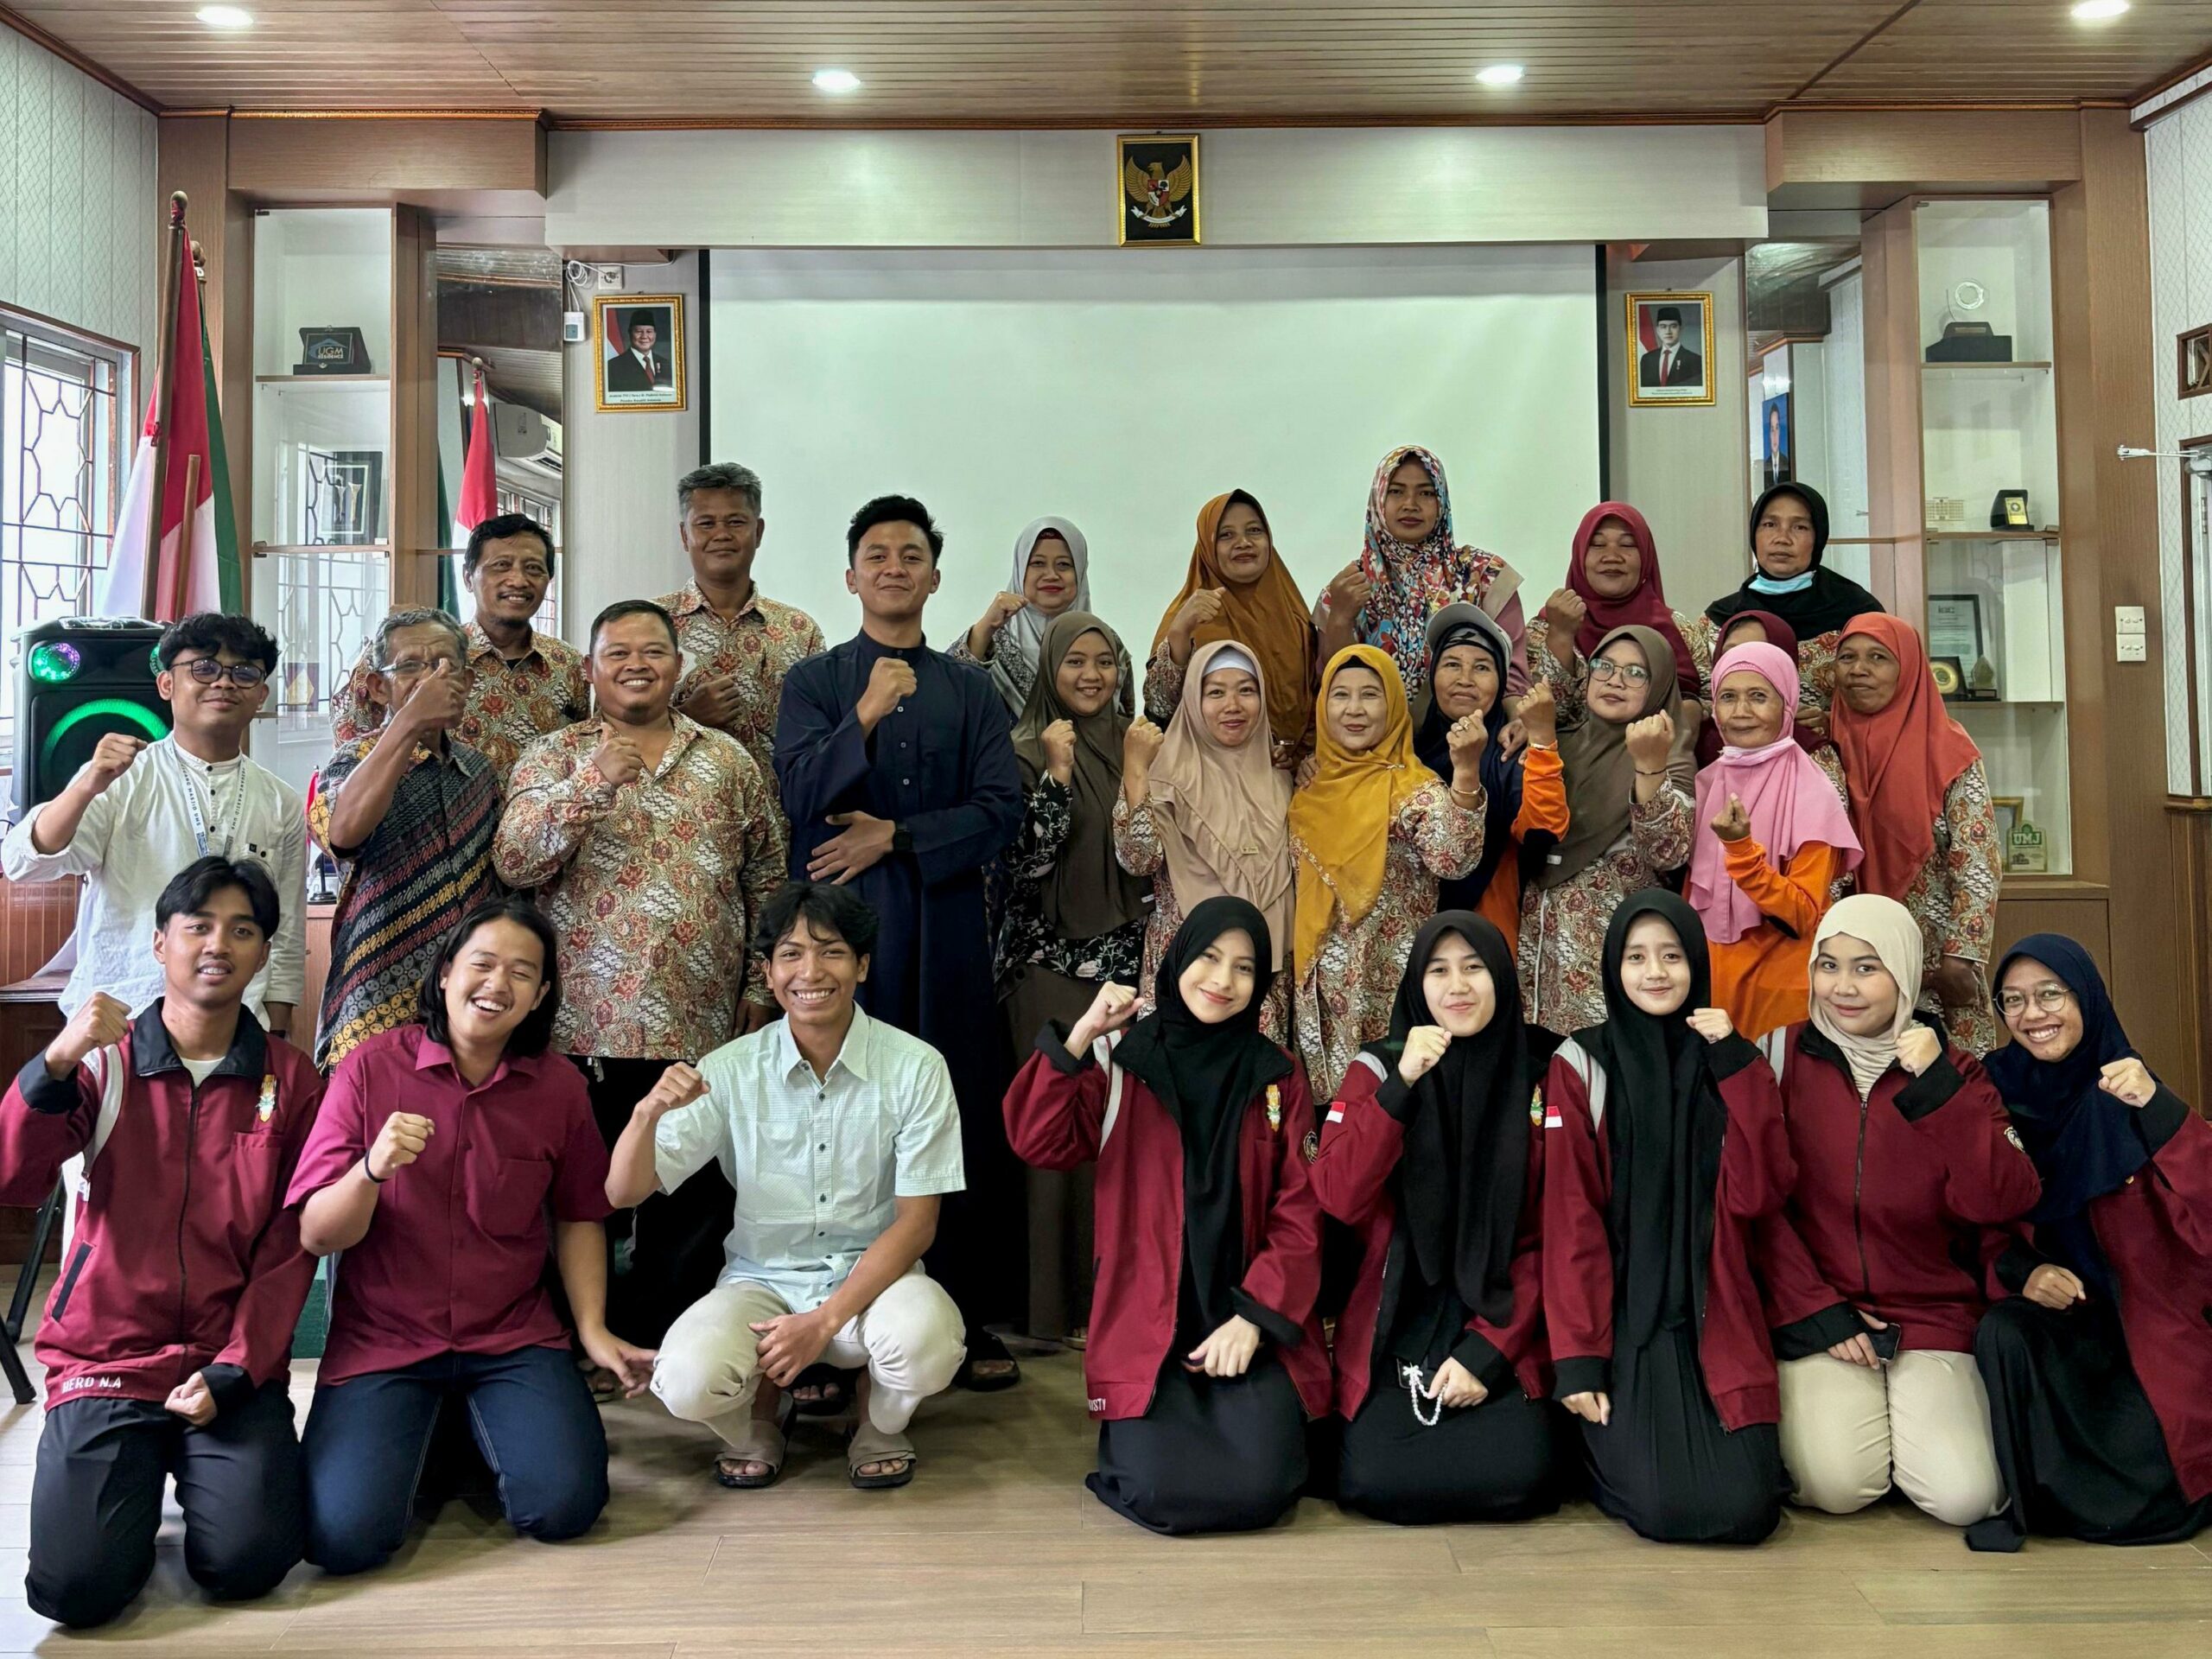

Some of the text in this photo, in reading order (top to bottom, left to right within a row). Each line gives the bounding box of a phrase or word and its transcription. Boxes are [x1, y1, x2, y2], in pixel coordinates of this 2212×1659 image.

[318, 346, 344, 355] UGM
[2013, 832, 2040, 844] UMJ
[62, 1376, 121, 1394] HERO N.A
